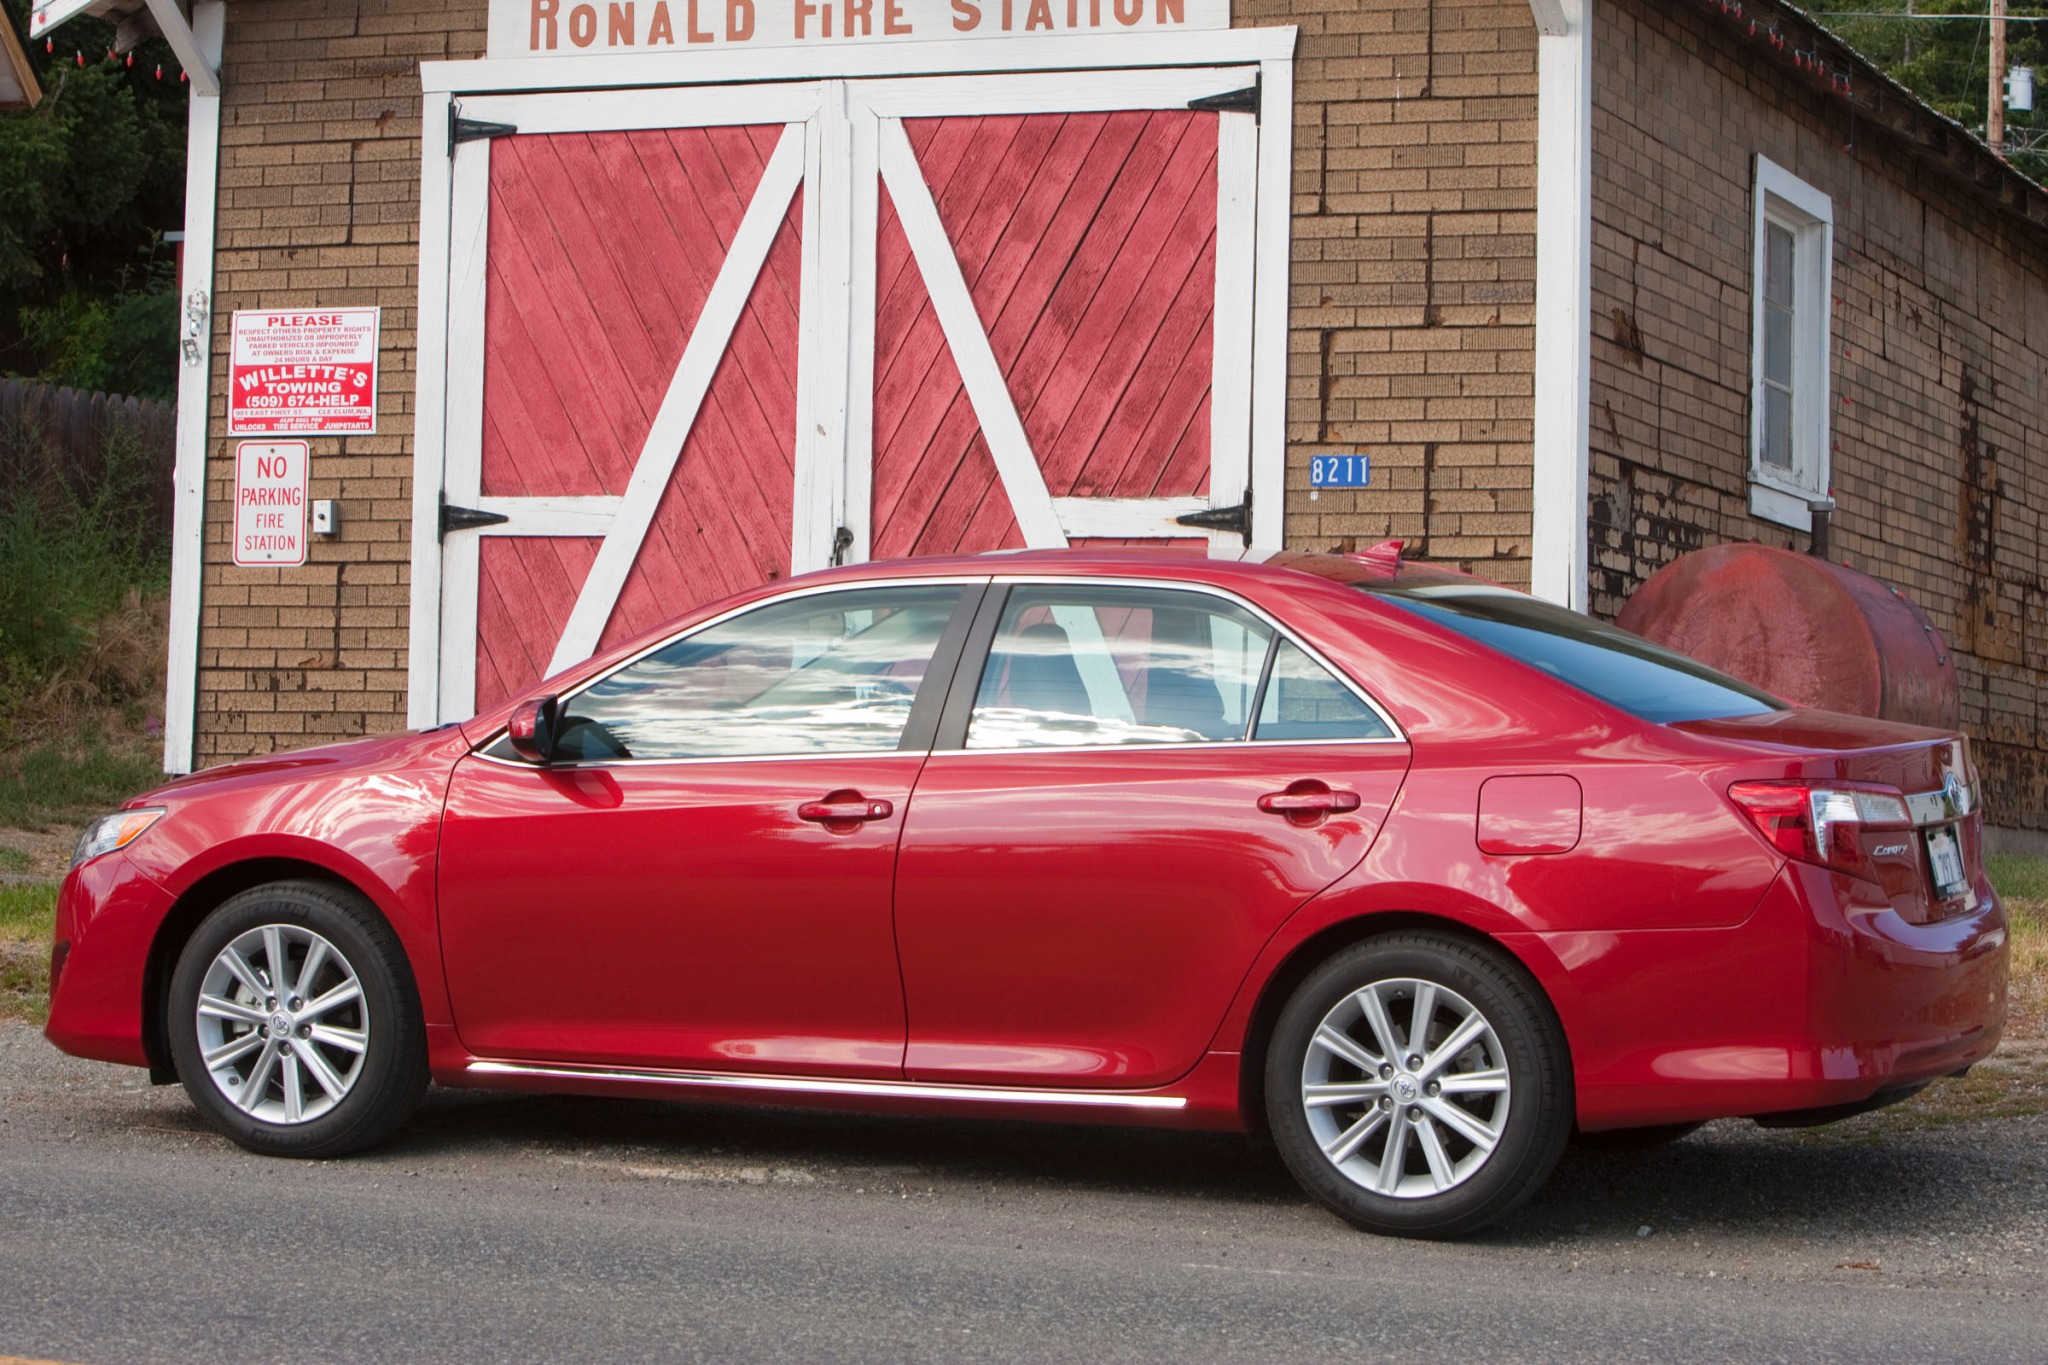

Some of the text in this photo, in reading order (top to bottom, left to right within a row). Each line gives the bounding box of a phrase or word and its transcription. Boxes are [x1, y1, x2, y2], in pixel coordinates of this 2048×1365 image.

[529, 0, 756, 51] RONALD
[268, 315, 343, 327] PLEASE
[239, 366, 368, 391] WILLETTE'S
[265, 382, 341, 394] TOWING
[246, 395, 359, 407] (509) 674-HELP
[257, 456, 287, 479] NO
[1312, 457, 1367, 484] 8211
[241, 487, 301, 505] PARKING
[256, 513, 285, 528] FIRE
[245, 535, 295, 550] STATION
